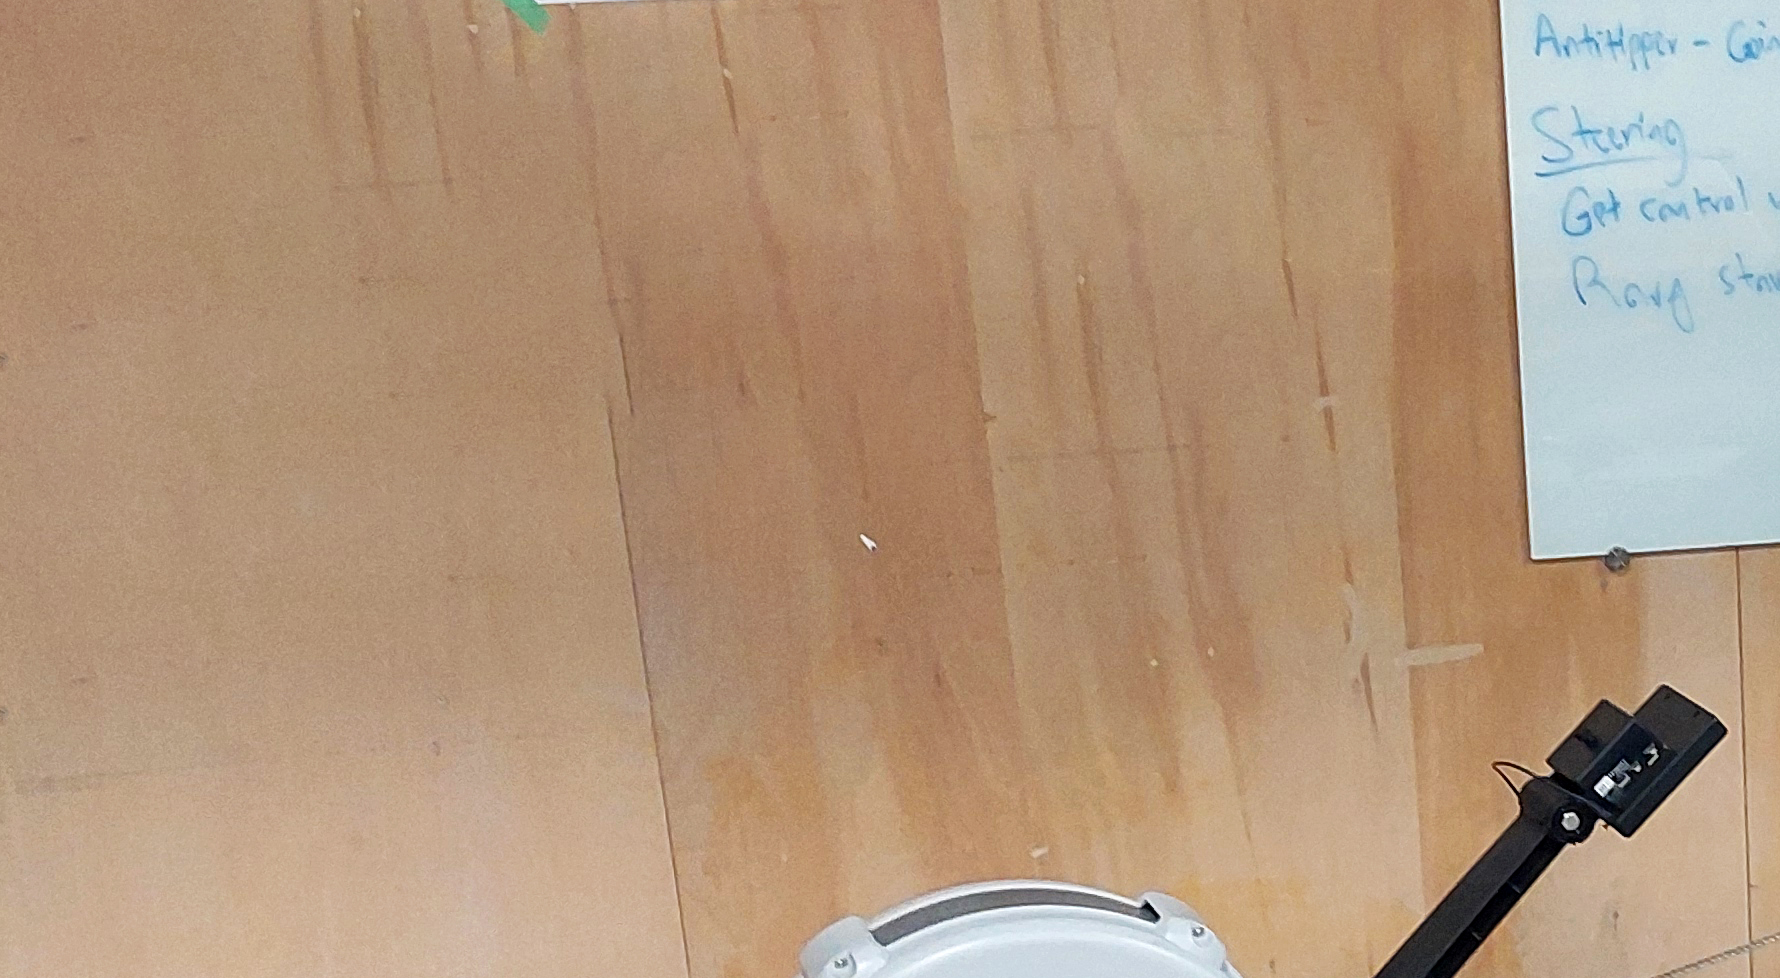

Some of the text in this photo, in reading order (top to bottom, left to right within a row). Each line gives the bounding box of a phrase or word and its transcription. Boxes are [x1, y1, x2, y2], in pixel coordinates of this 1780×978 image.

[1531, 104, 1688, 188] Steering
[1561, 185, 1621, 237] Get
[1640, 175, 1749, 222] control
